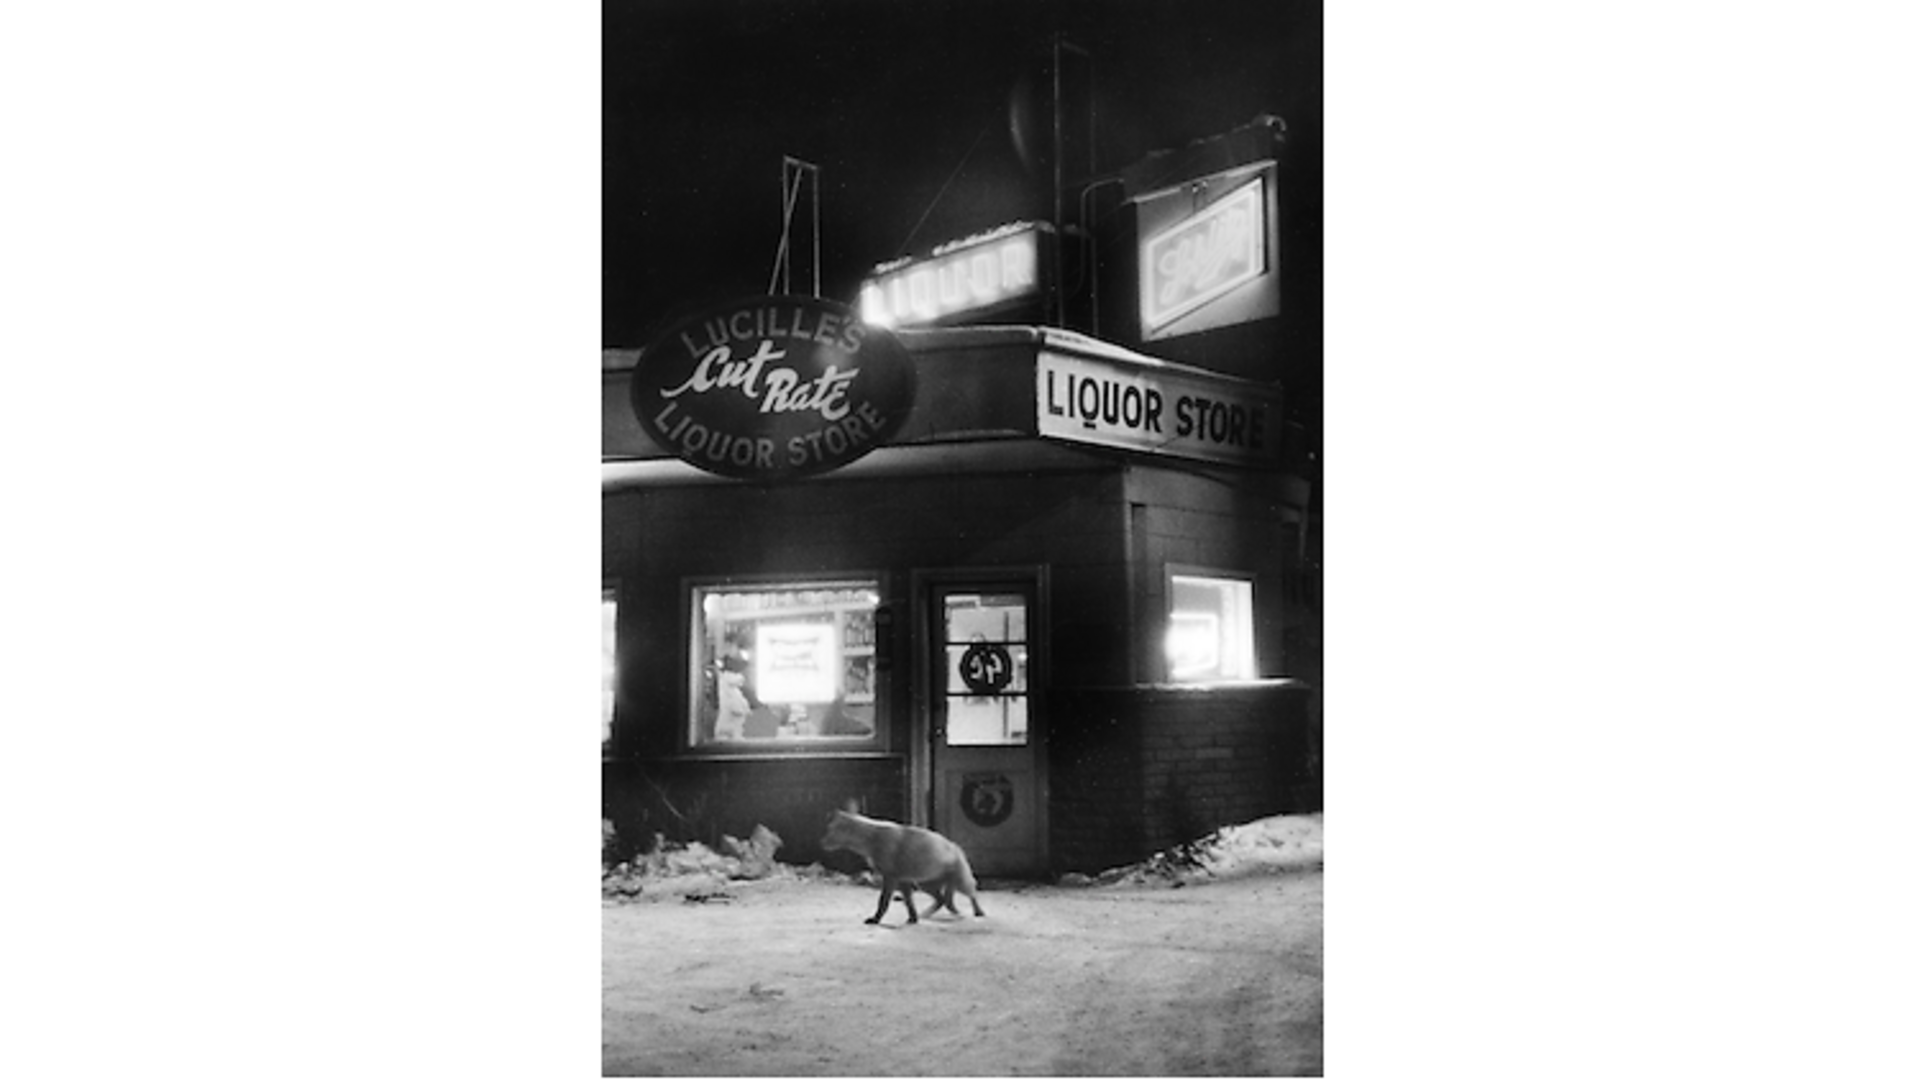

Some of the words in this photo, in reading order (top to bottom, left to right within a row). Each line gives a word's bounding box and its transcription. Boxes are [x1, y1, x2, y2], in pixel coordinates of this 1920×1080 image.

[861, 238, 1034, 330] LIQUOR
[680, 307, 867, 359] LUCILLE'S
[660, 339, 787, 398] Cut
[653, 401, 775, 468] LIQUOR
[787, 400, 887, 466] STORE
[1047, 369, 1164, 434] LIQUOR
[1175, 395, 1266, 450] STORE
